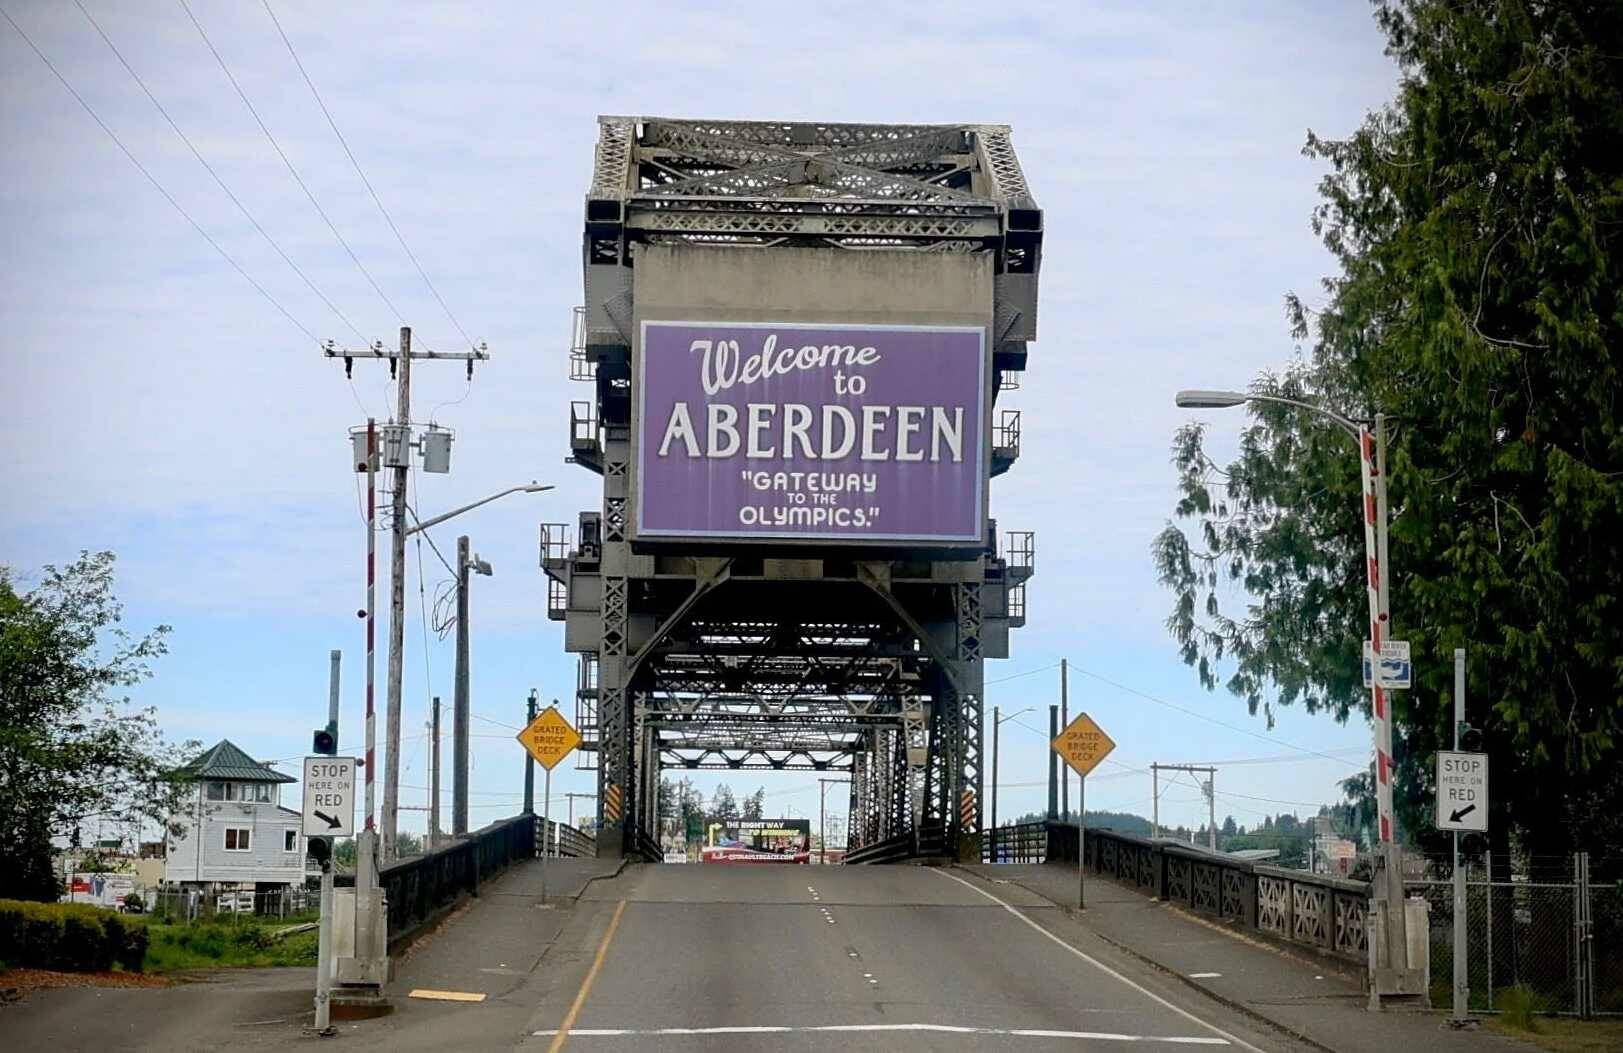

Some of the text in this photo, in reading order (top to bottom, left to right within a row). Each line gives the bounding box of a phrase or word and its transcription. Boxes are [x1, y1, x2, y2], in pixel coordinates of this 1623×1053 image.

[690, 334, 881, 395] Welcome
[834, 370, 866, 395] to
[658, 402, 964, 462] ABERDEEN
[788, 493, 837, 504] TO THE
[534, 726, 567, 734] GRATED
[534, 736, 565, 744] BRIDGE
[538, 746, 560, 754] DECK
[1071, 752, 1093, 761] DECK
[311, 765, 348, 777] STOP
[1444, 760, 1480, 772] STOP
[1443, 776, 1482, 785] HERE ON
[315, 794, 342, 806] RED
[1449, 789, 1475, 801] RED
